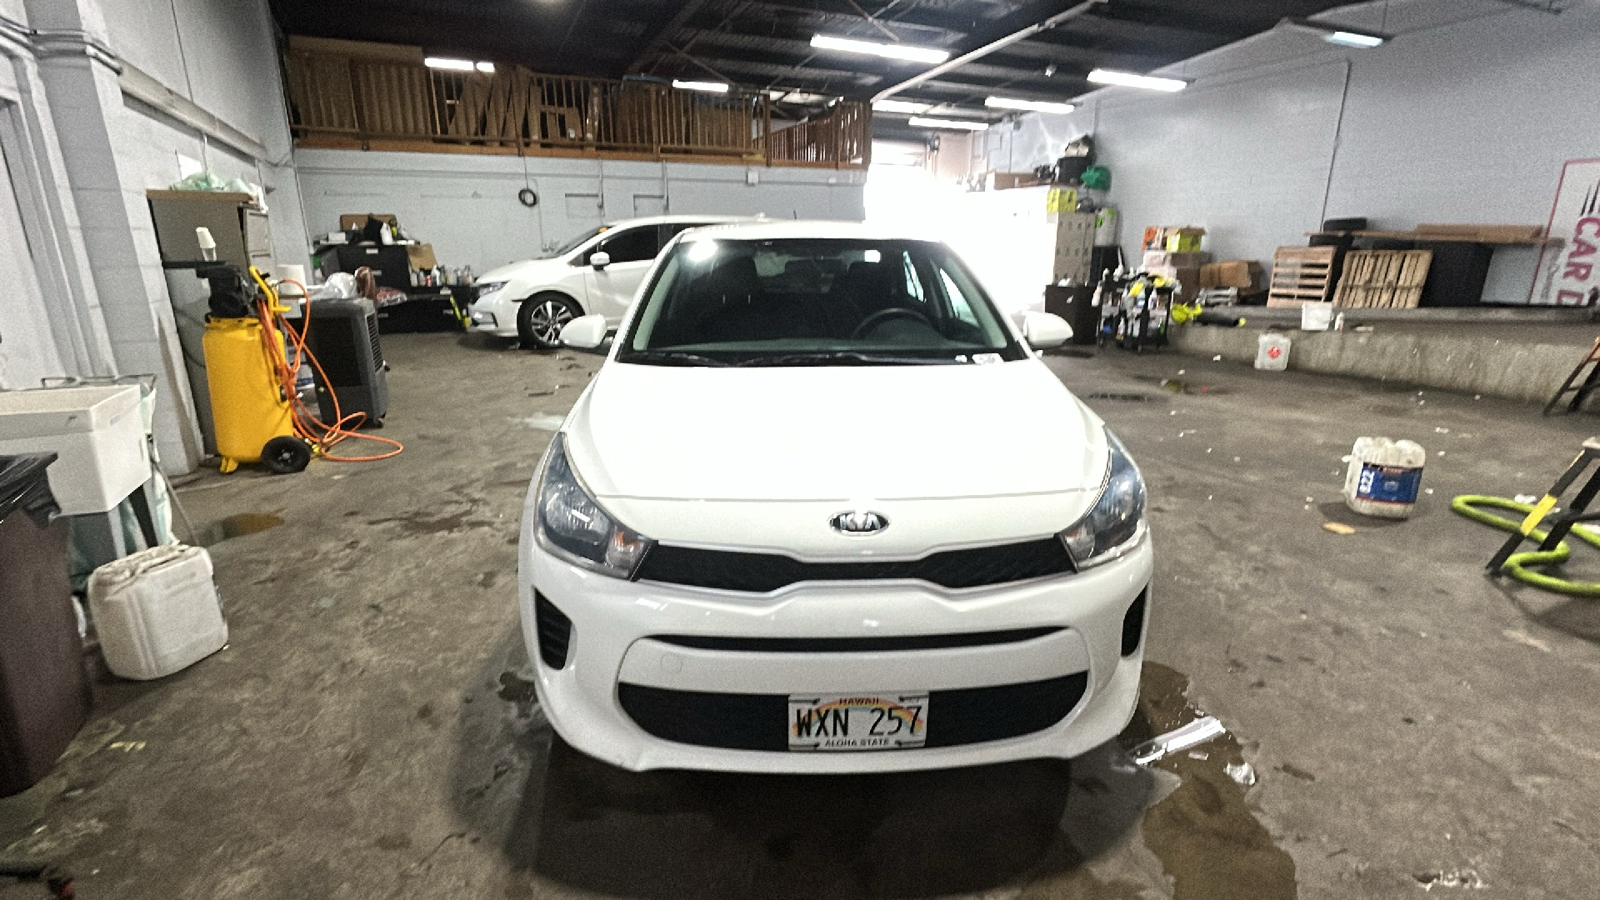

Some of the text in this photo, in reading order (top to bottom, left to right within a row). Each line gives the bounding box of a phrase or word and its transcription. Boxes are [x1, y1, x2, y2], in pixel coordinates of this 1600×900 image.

[1562, 217, 1600, 280] CAR
[839, 512, 881, 531] KIA
[839, 697, 880, 706] HAWAII
[796, 705, 922, 738] WXN 257
[825, 738, 890, 748] ALOHA STATE
